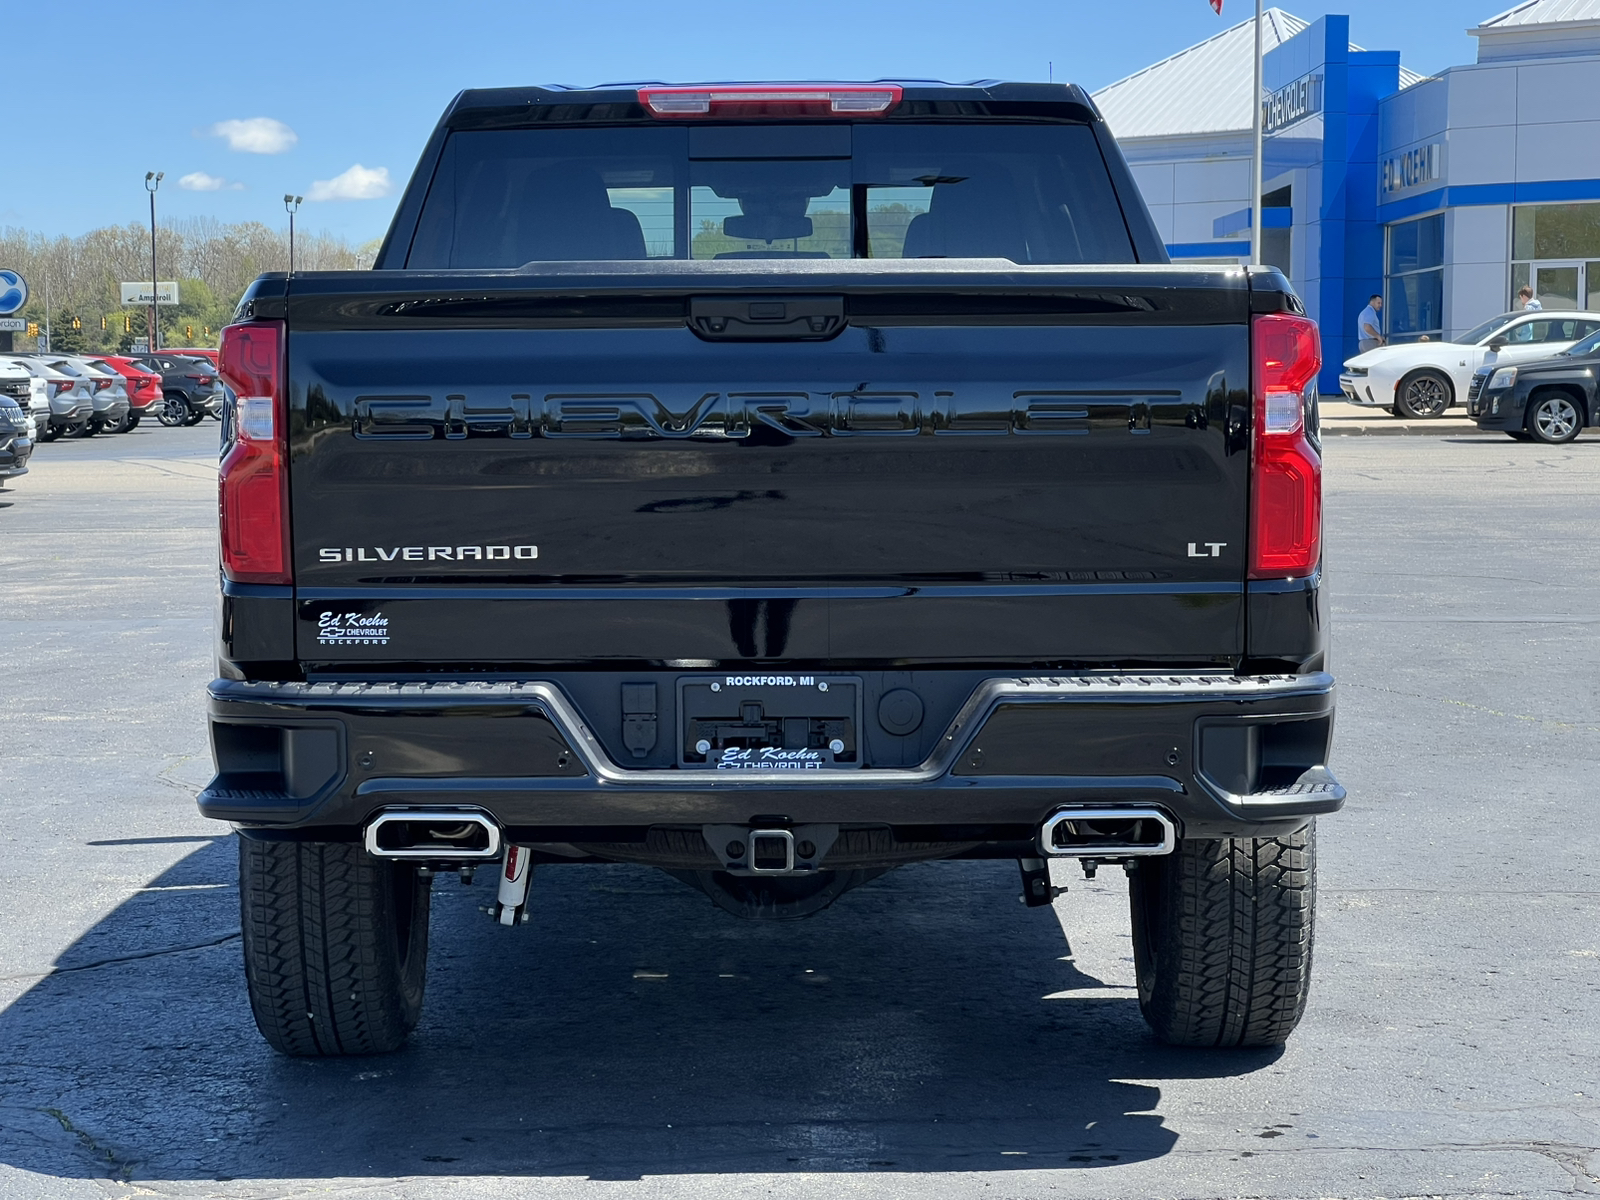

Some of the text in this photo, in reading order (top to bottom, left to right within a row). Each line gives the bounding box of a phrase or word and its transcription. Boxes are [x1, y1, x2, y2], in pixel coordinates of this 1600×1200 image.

[1267, 74, 1311, 130] CHEVROLET
[1383, 144, 1434, 193] ED KOEHN
[0, 319, 21, 327] rdon
[353, 390, 1182, 440] CHEVROLET
[319, 545, 539, 562] SILVERADO
[1187, 542, 1228, 557] LT
[318, 611, 389, 627] Ed Koehn
[346, 628, 388, 636] CHEVROLET
[726, 676, 815, 687] ROCKFORD, MI
[721, 746, 819, 760] Ed Koehn
[743, 761, 823, 769] CHEVROLET
